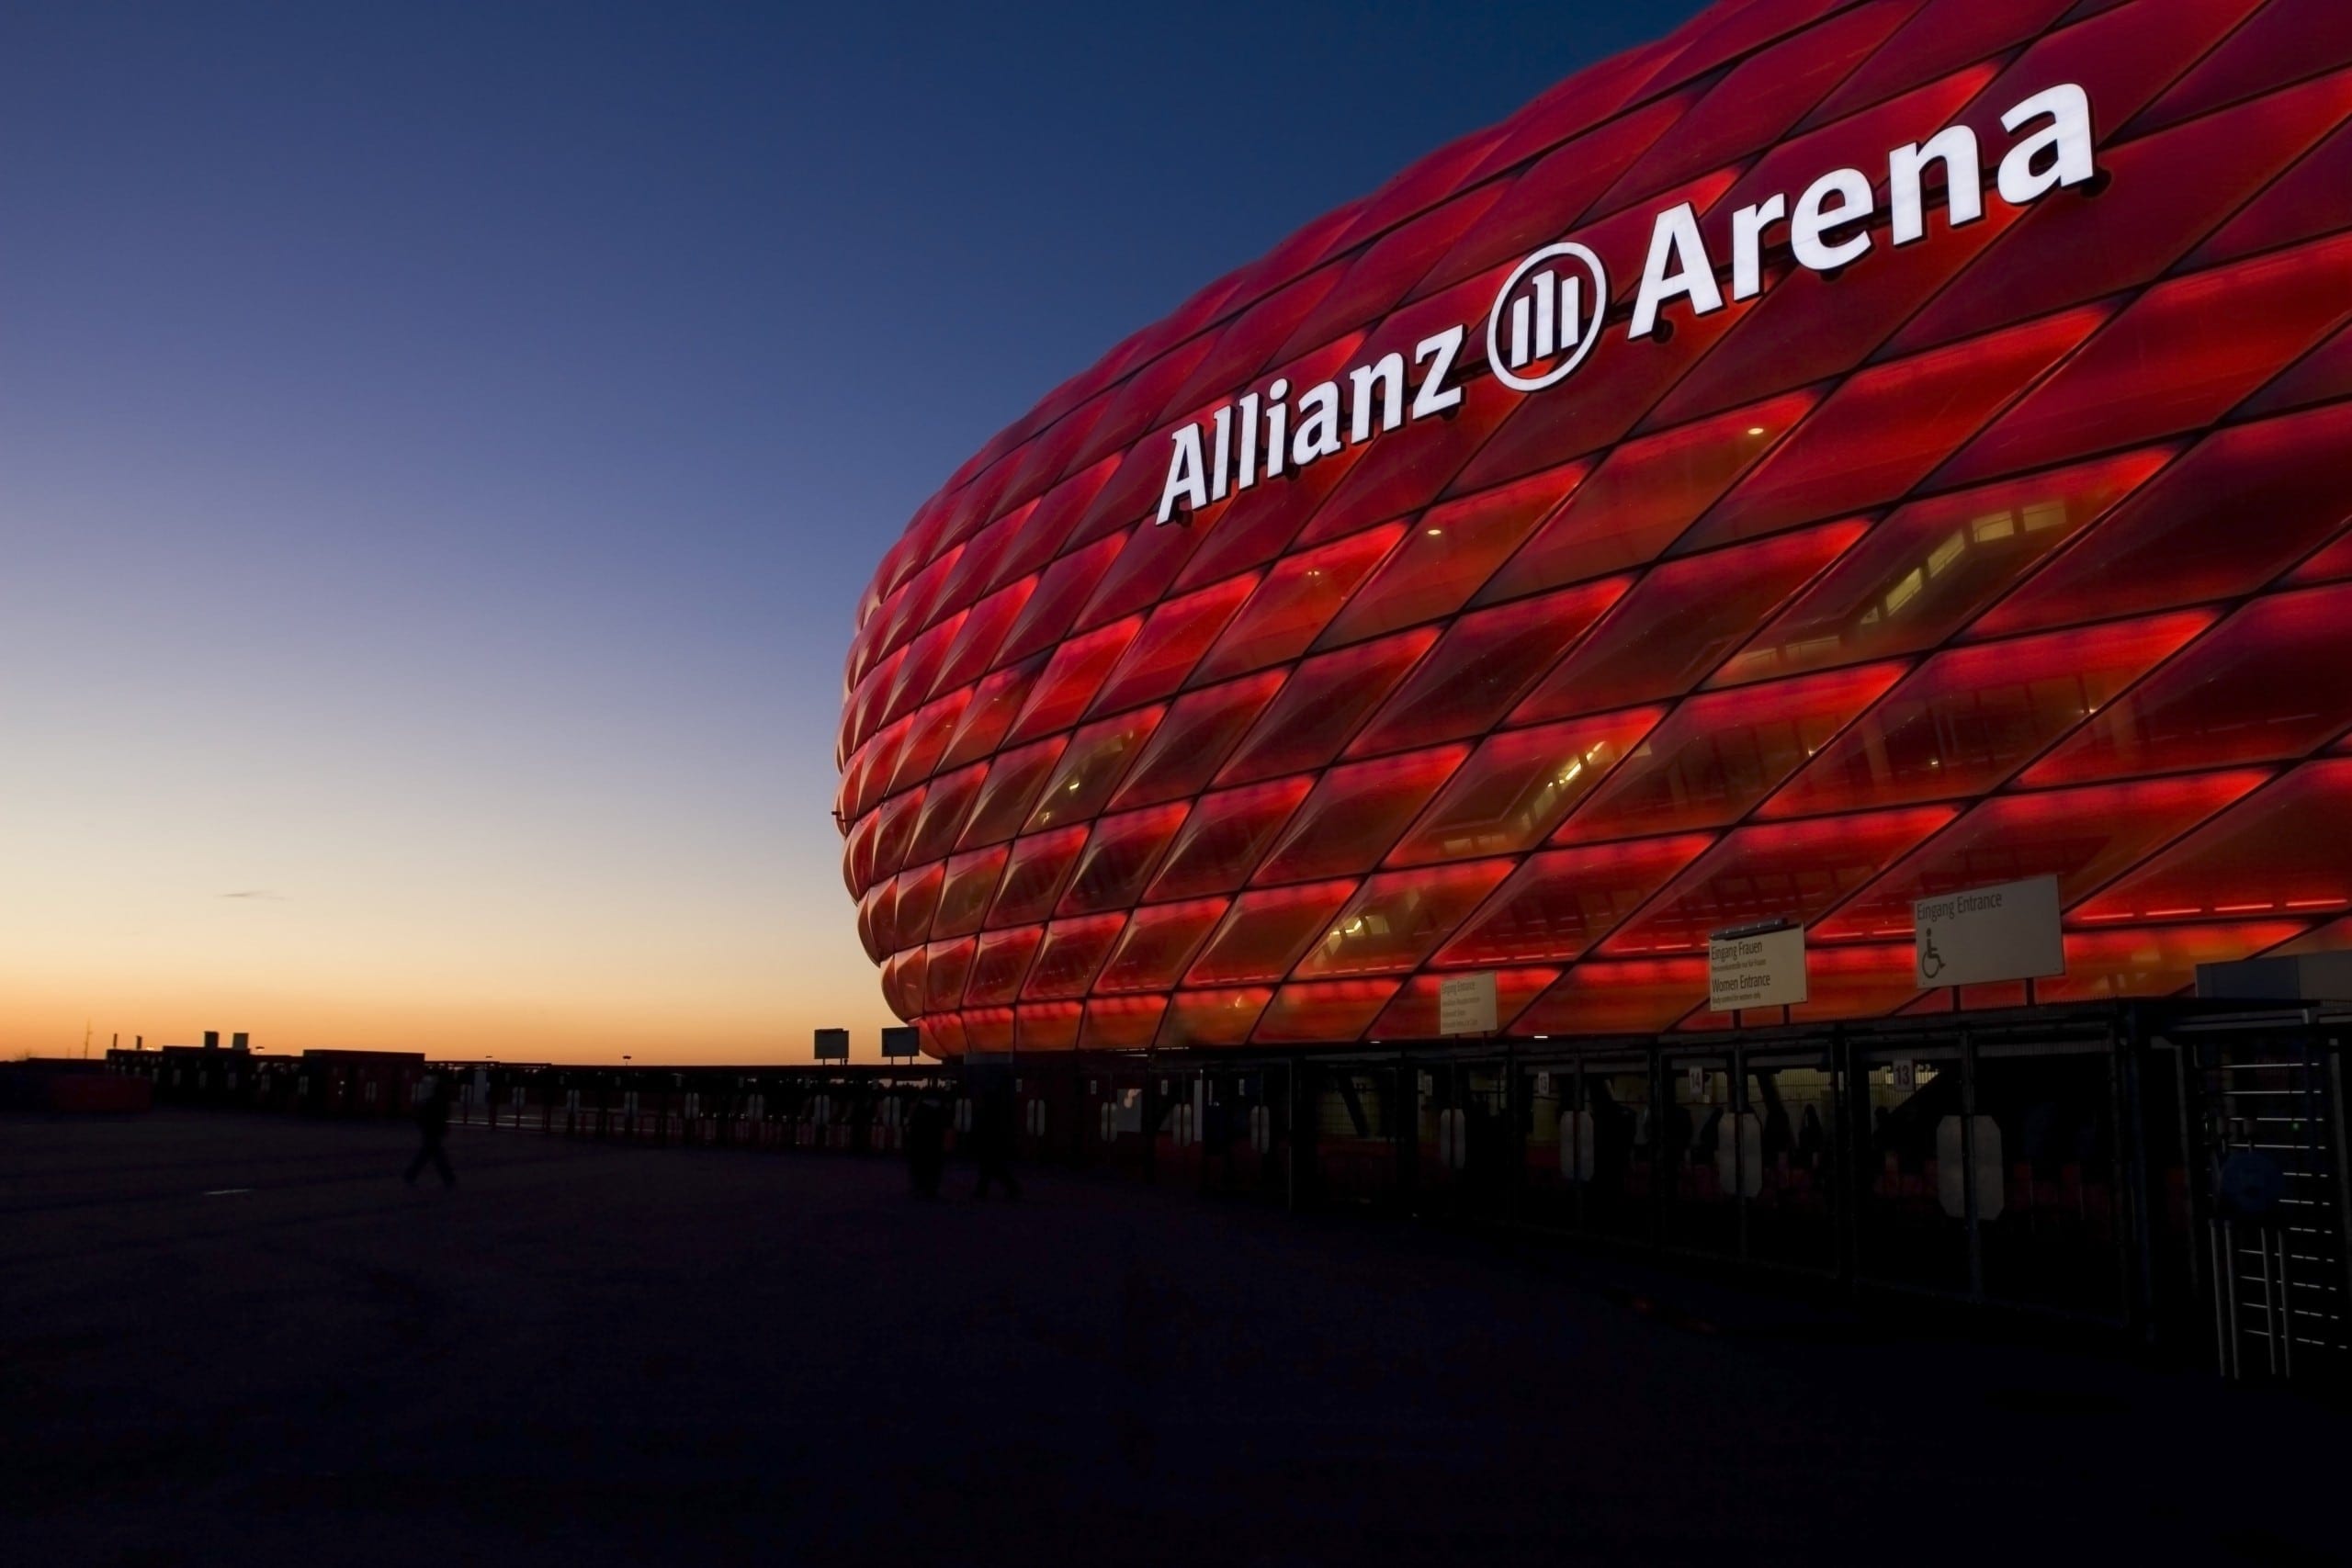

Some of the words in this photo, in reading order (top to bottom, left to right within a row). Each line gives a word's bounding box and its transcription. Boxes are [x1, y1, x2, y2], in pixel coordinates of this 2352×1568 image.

[1156, 323, 1464, 525] Allianz
[1628, 83, 2095, 339] Arena
[1917, 902, 1955, 922] Eingang
[1957, 894, 2002, 914] Entrance
[1712, 946, 1737, 963] Eingang
[1738, 941, 1763, 956] Frauen
[1712, 977, 1738, 993] Women
[1740, 974, 1770, 989] Entrance
[1690, 1072, 1702, 1089] 14
[1895, 1065, 1910, 1086] 13
